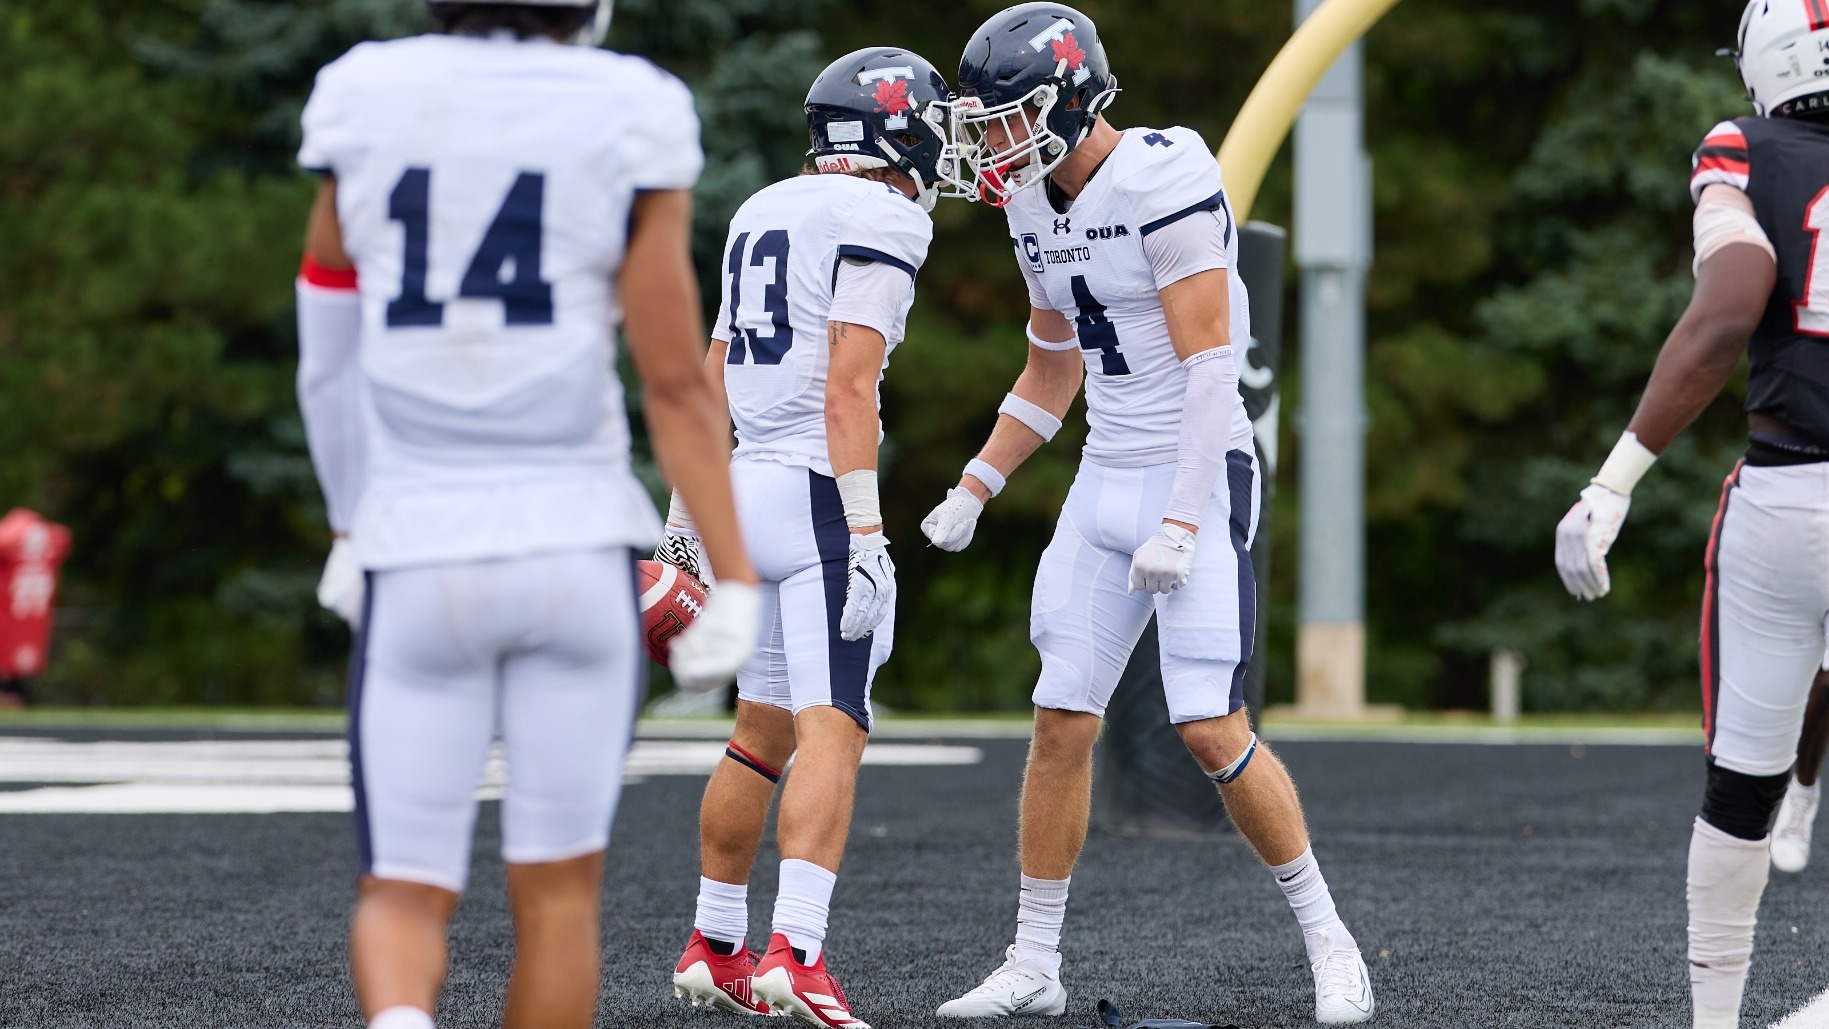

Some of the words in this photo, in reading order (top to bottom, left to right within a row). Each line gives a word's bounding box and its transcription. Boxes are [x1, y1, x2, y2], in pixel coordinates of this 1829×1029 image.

[833, 143, 859, 151] OUA
[1142, 132, 1174, 148] 4
[1086, 224, 1130, 241] OUA
[385, 167, 554, 328] 14
[1023, 235, 1040, 263] C
[1044, 247, 1090, 265] TORONTO
[727, 230, 794, 365] 13
[1071, 275, 1132, 376] 4
